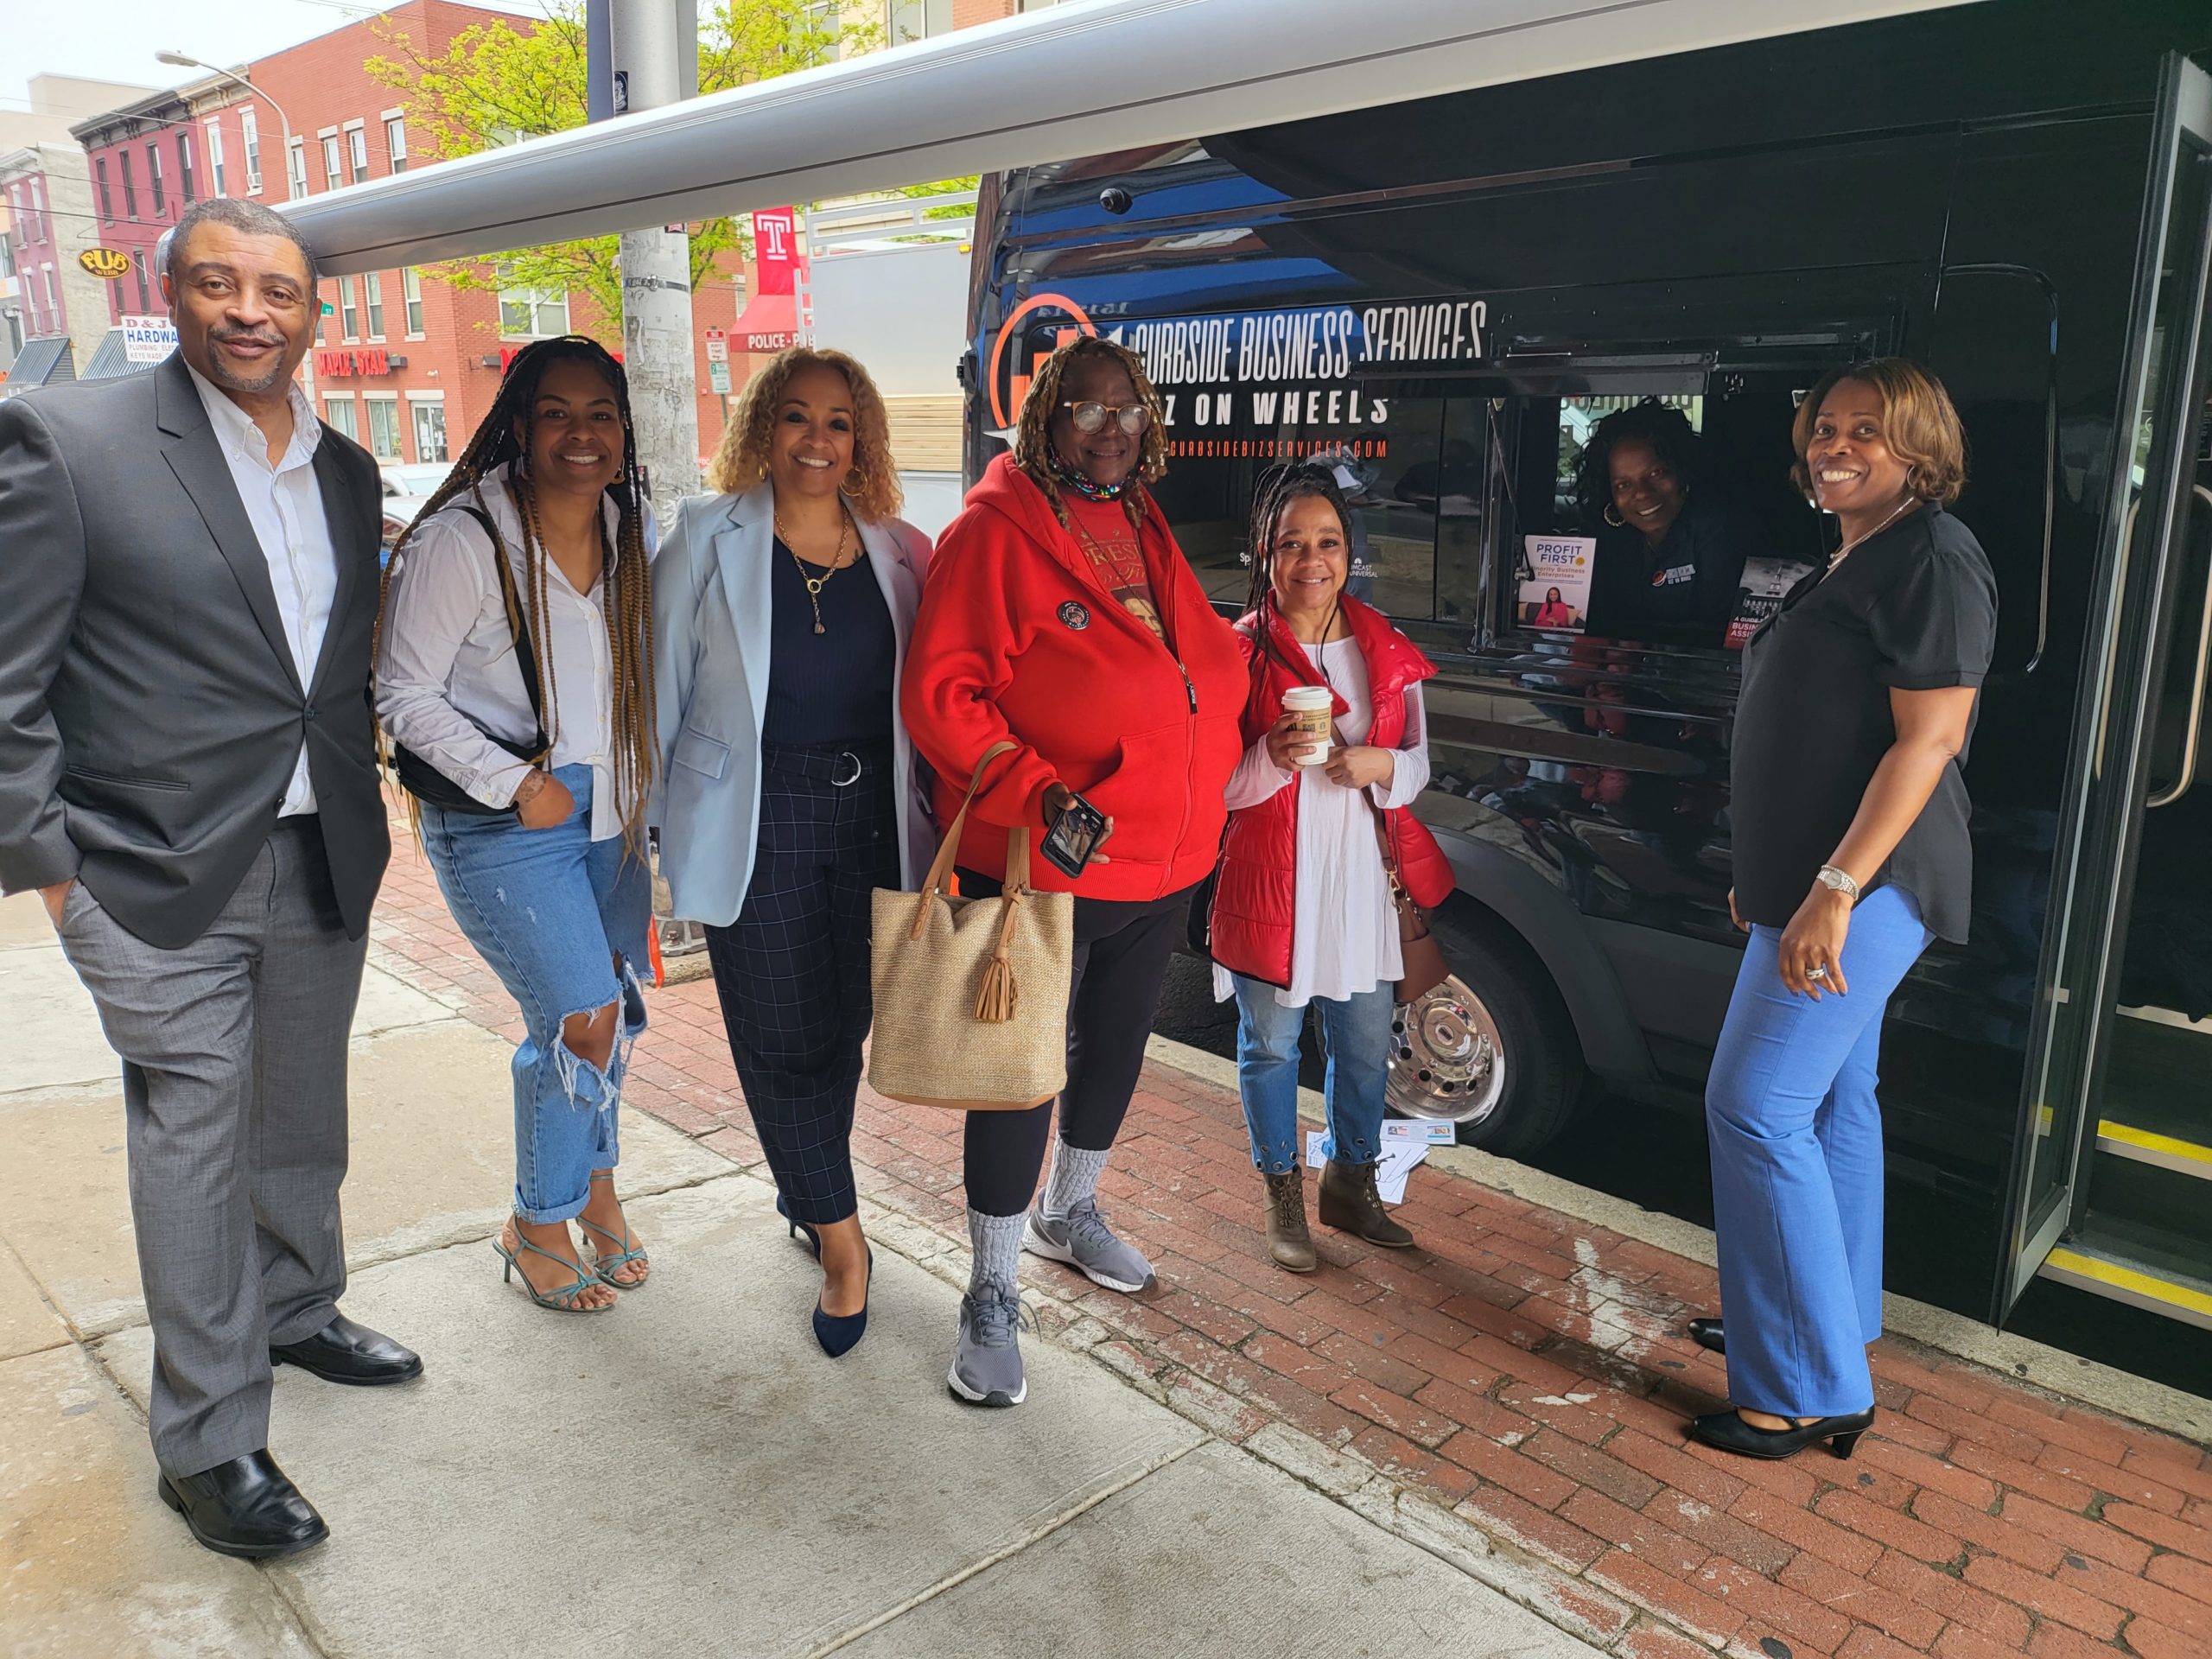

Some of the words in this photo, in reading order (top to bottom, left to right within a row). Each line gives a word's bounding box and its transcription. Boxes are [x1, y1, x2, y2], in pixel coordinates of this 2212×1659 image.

[79, 250, 127, 270] PUB
[125, 319, 138, 327] D
[141, 319, 154, 328] &
[157, 320, 167, 328] J
[748, 333, 785, 349] POLICE
[1135, 318, 1235, 385] CURBSIDE
[1238, 309, 1353, 382] BUSINESS
[1359, 301, 1487, 361] SERVICES
[1195, 393, 1232, 426] ON
[1253, 390, 1389, 425] WHEELS
[1170, 441, 1387, 458] CURBSIDEBIZSERVICESCOM
[1536, 543, 1582, 555] PROFIT
[1540, 554, 1575, 564] FIRST
[1731, 629, 1753, 638] ASSI
